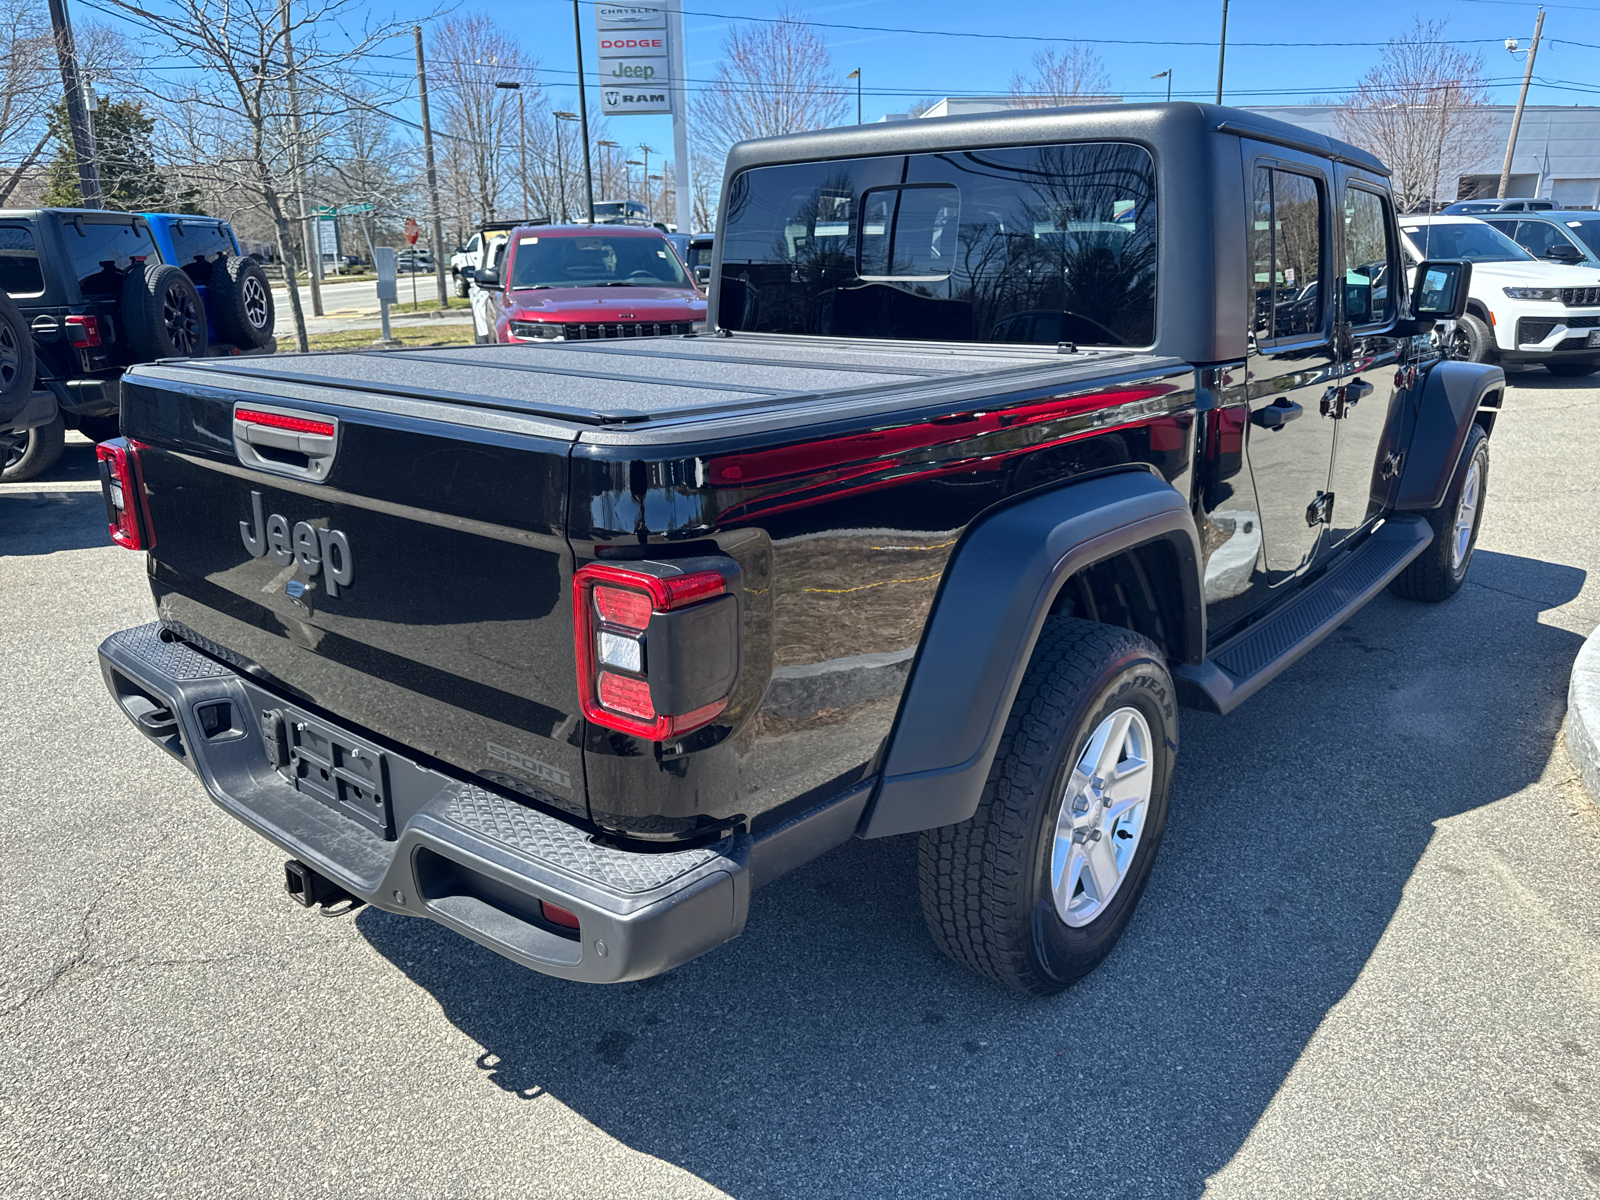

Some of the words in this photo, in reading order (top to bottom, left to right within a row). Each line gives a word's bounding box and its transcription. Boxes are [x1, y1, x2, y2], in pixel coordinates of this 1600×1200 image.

[601, 39, 662, 48] DODGE
[612, 62, 655, 80] Jeep
[622, 94, 665, 103] RAM
[239, 490, 354, 598] Jeep
[486, 741, 571, 788] SPORT
